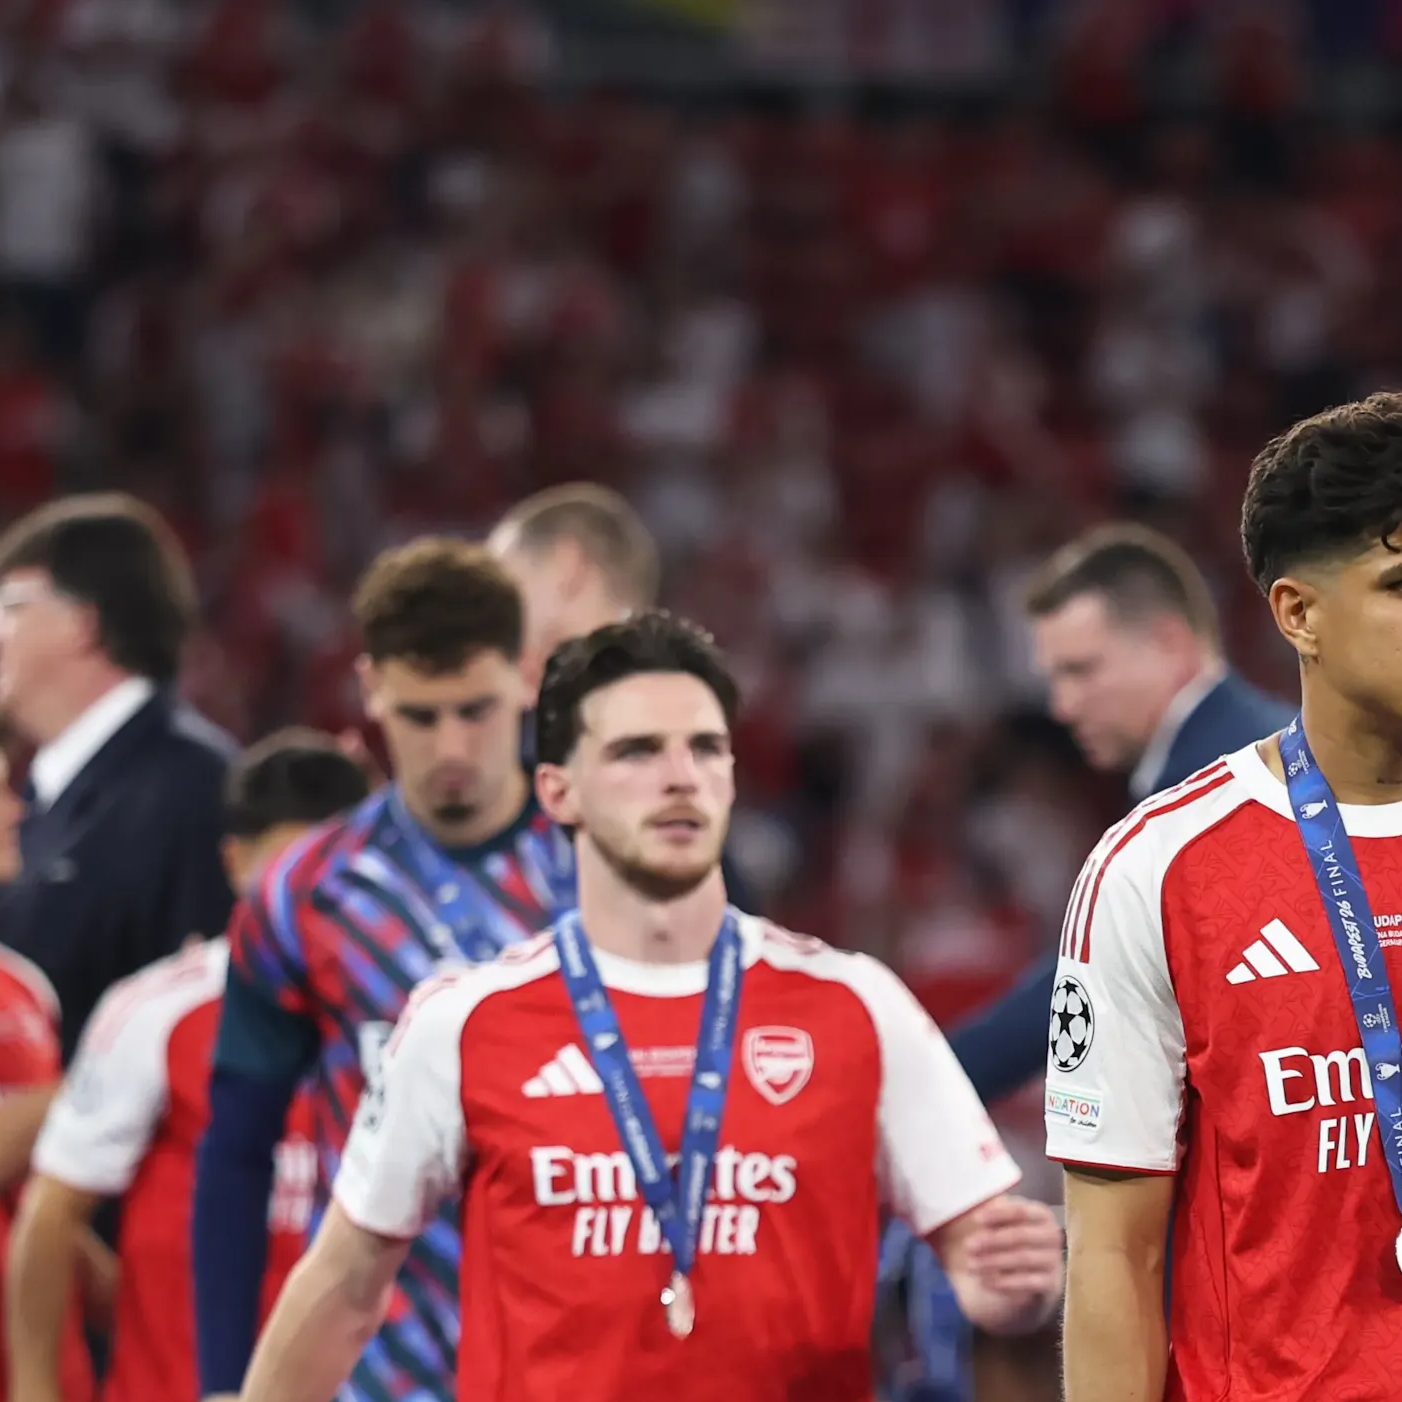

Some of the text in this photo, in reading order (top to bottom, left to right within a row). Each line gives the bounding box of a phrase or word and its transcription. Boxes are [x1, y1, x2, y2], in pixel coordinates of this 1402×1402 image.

[1320, 840, 1373, 979] BUDAPEST 26 FINAL
[1318, 1111, 1375, 1174] FLY
[529, 1144, 798, 1206] Emtes
[571, 1205, 633, 1258] FLY
[637, 1204, 761, 1256] BTER
